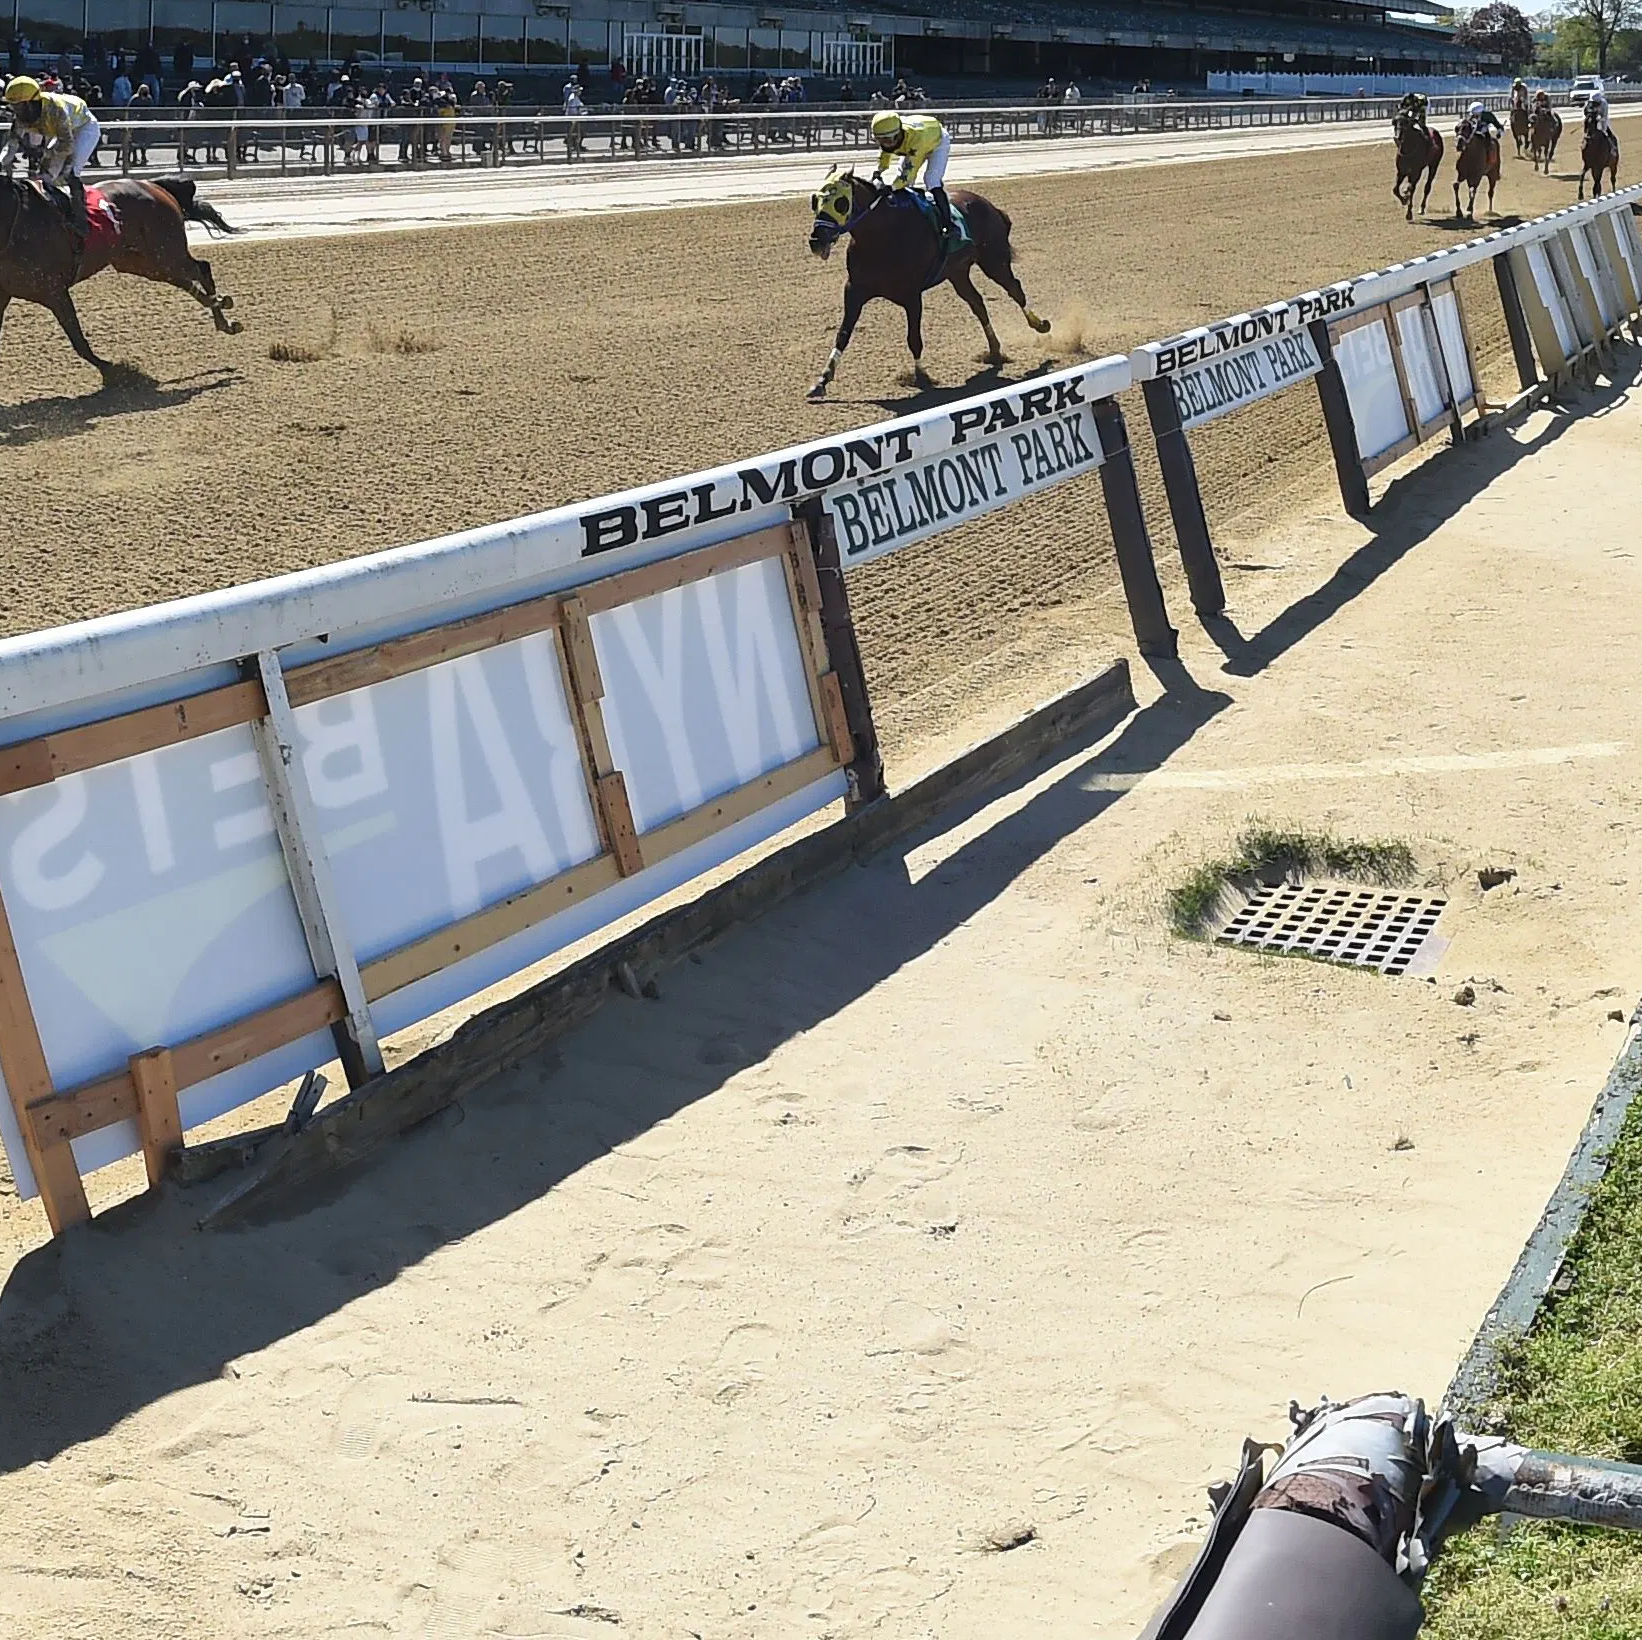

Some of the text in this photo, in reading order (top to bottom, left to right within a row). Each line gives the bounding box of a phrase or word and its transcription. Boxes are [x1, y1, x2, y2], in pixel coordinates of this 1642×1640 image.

[1155, 310, 1289, 376] BELMONT
[1297, 286, 1356, 325] PARK
[1171, 350, 1267, 422] BELMONT
[1262, 331, 1316, 383] PARK
[579, 375, 1086, 557] BELMONT PARK
[832, 412, 1094, 556] BELMONT PARK
